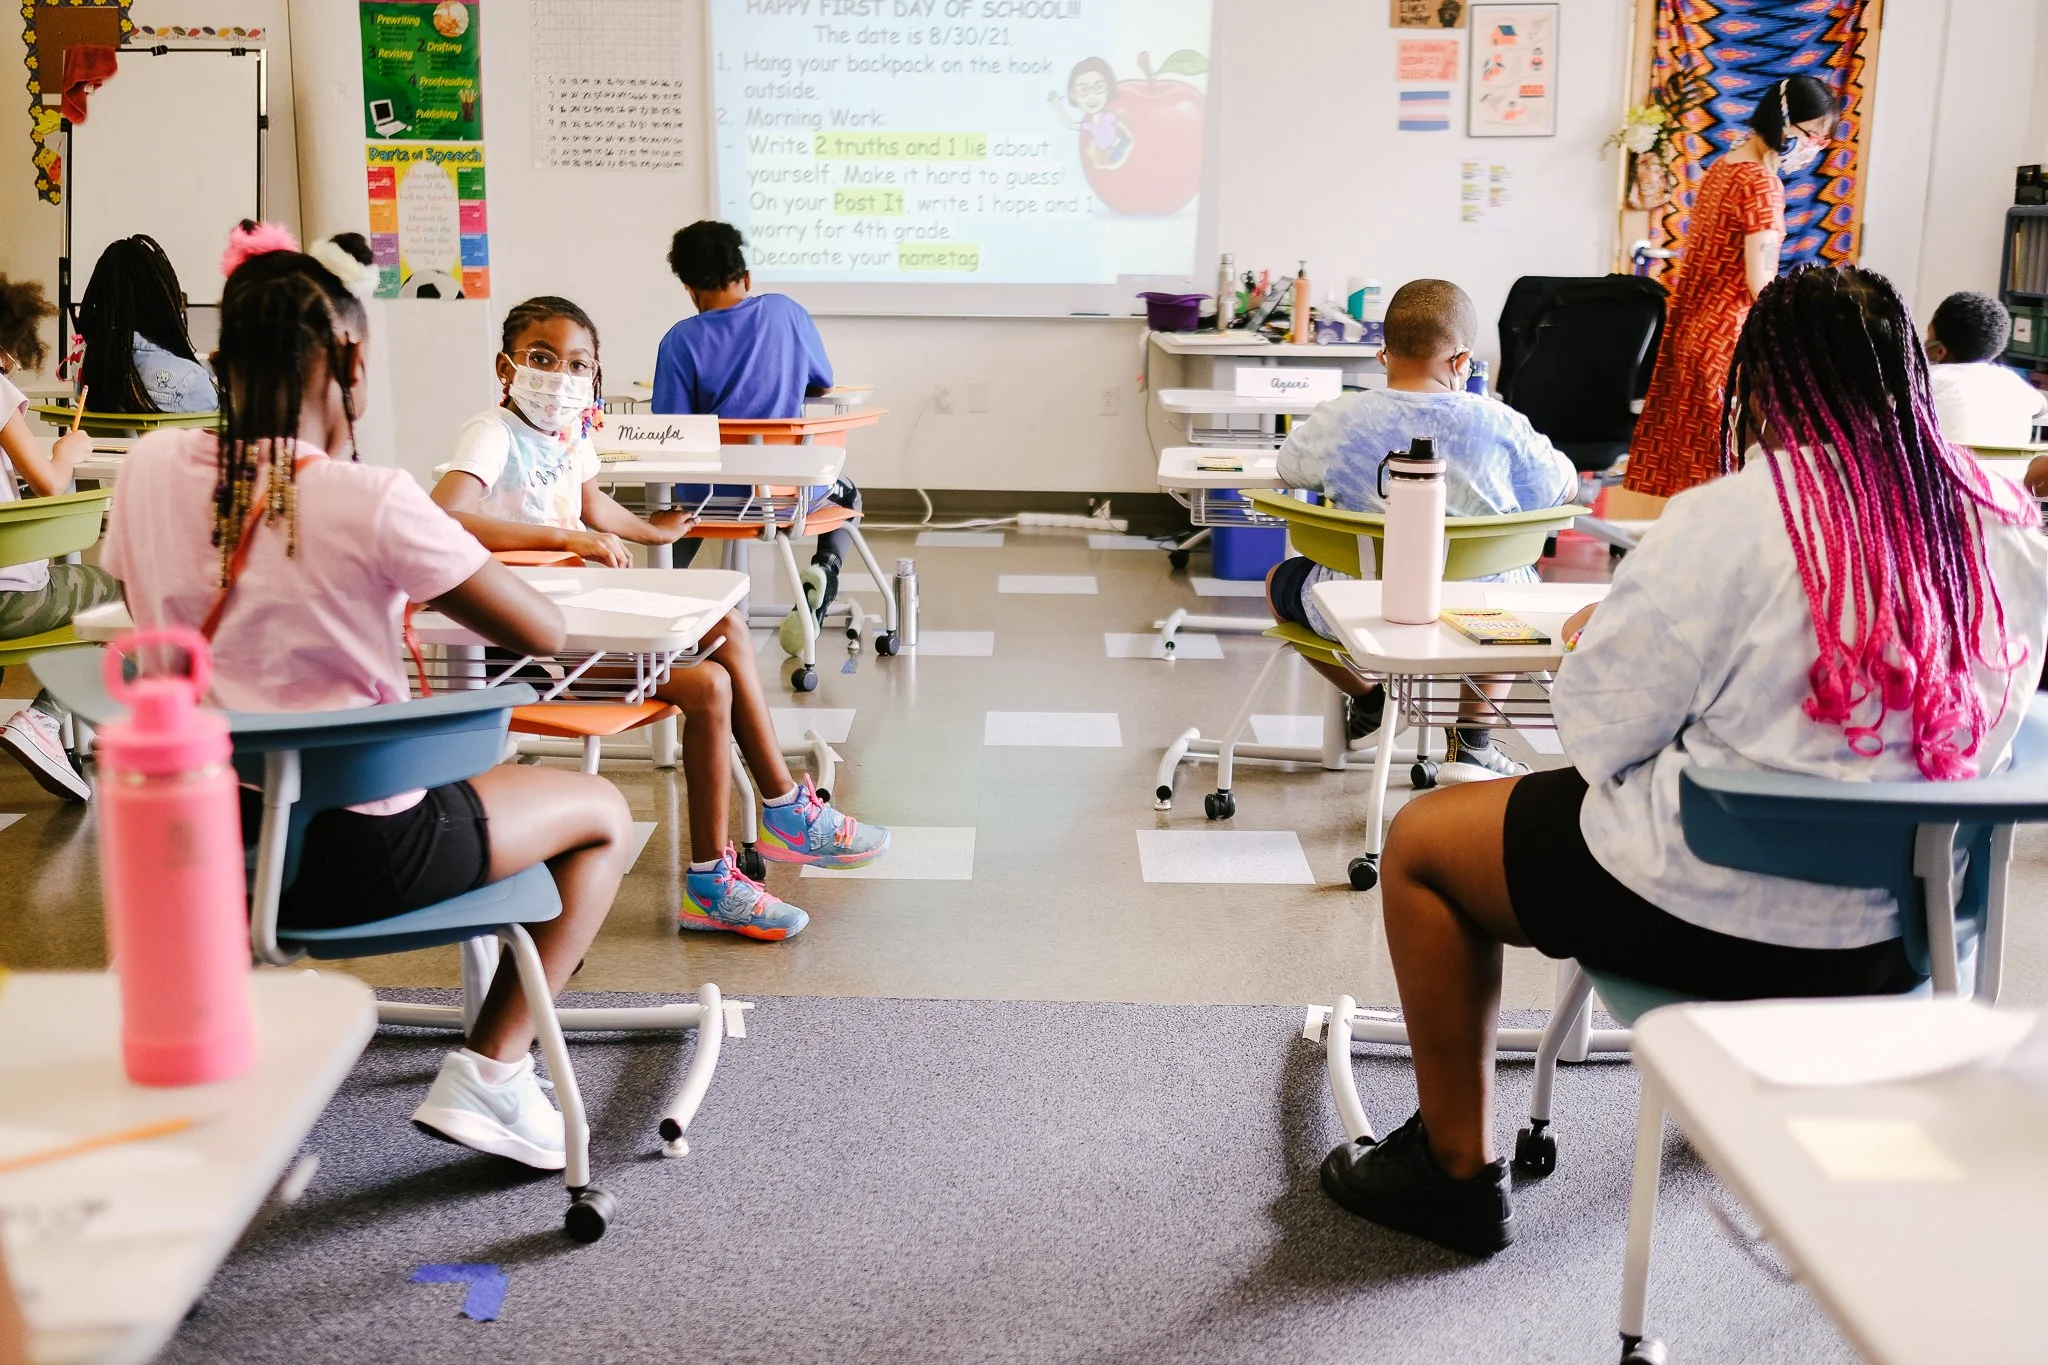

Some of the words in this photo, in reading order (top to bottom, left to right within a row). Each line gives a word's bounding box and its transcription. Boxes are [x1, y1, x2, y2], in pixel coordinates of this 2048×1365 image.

[747, 0, 808, 16] HAPPY
[820, 0, 882, 17] FIRST
[893, 0, 936, 18] DAY
[944, 0, 973, 18] OF
[377, 14, 420, 27] Prewriting
[813, 24, 851, 44] The
[856, 26, 901, 44] date
[906, 27, 922, 44] is
[929, 26, 1015, 47] 8/30/21.
[378, 48, 414, 60] Revising
[427, 41, 463, 54] Drafting
[716, 51, 731, 71] 1.
[743, 52, 792, 77] Hang
[798, 57, 840, 77] your
[847, 53, 936, 78] backpack
[941, 59, 963, 74] on
[970, 55, 1002, 74] the
[1008, 55, 1053, 74] hook
[420, 76, 473, 88] Proofreading
[744, 80, 820, 100] outside.
[416, 108, 458, 121] Publishing
[716, 106, 733, 126] 2.
[745, 107, 824, 131] Morning
[829, 108, 887, 127] Work:
[368, 147, 410, 162] Parts
[412, 150, 423, 159] of
[426, 147, 482, 165] Speech
[749, 135, 808, 155] Write
[814, 136, 827, 155] 2
[834, 136, 899, 156] truths
[905, 136, 940, 156] and
[948, 137, 956, 156] 1
[964, 137, 987, 156] lie
[994, 137, 1050, 157] about
[748, 163, 836, 187] yourself.
[843, 165, 897, 185] Make
[903, 166, 918, 185] it
[926, 166, 971, 185] hard
[979, 168, 999, 185] to
[1006, 166, 1065, 190] guess!
[750, 191, 777, 211] On
[783, 194, 827, 215] your
[833, 192, 876, 211] Post
[917, 194, 970, 212] write
[976, 194, 985, 212] 1
[992, 194, 1039, 217] hope
[1044, 194, 1079, 213] and
[1086, 195, 1094, 213] 1
[751, 223, 807, 241] worry
[814, 219, 846, 238] for
[852, 220, 887, 239] 4th
[894, 221, 956, 244] grade.
[752, 247, 843, 266] Decorate
[850, 252, 892, 271] your
[618, 424, 684, 445] Micayla
